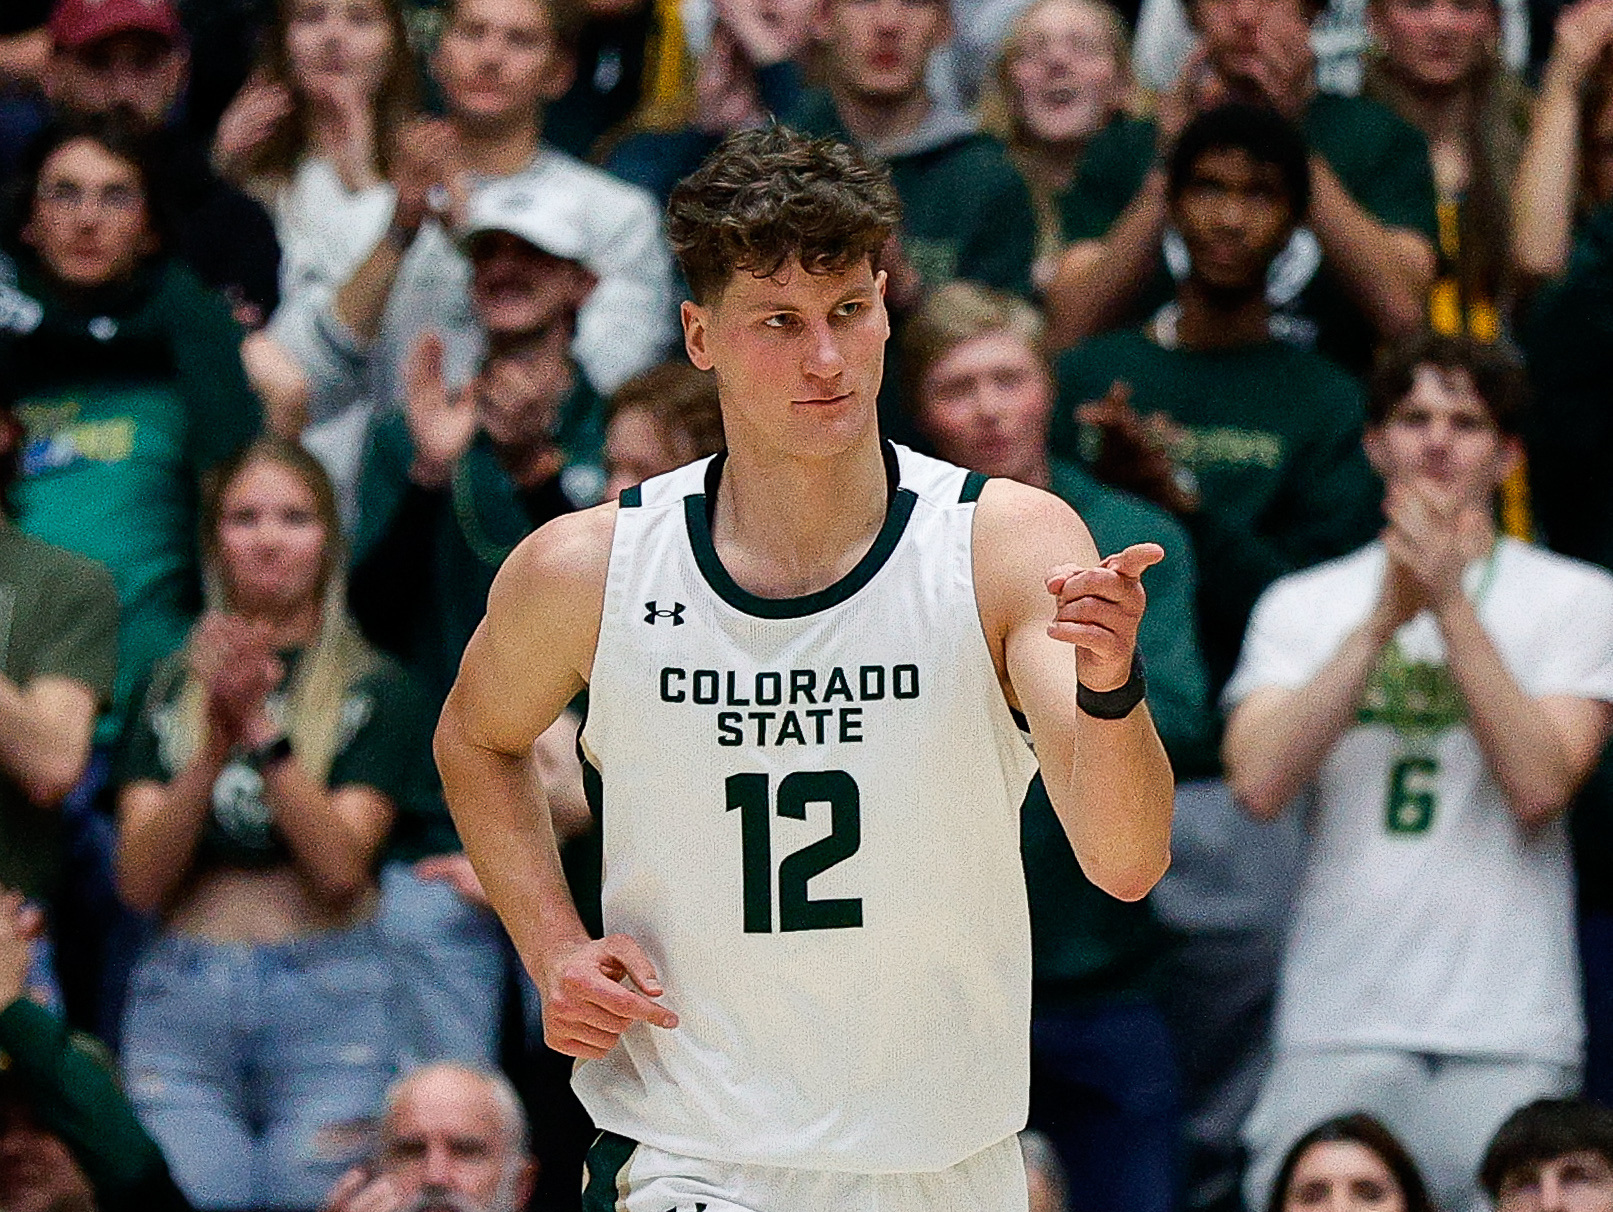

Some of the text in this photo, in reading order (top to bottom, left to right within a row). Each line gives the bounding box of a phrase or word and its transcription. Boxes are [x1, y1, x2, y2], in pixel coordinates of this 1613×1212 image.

[660, 664, 919, 706] COLORADO
[717, 708, 863, 746] STATE
[1387, 757, 1439, 833] 6
[725, 769, 863, 933] 12
